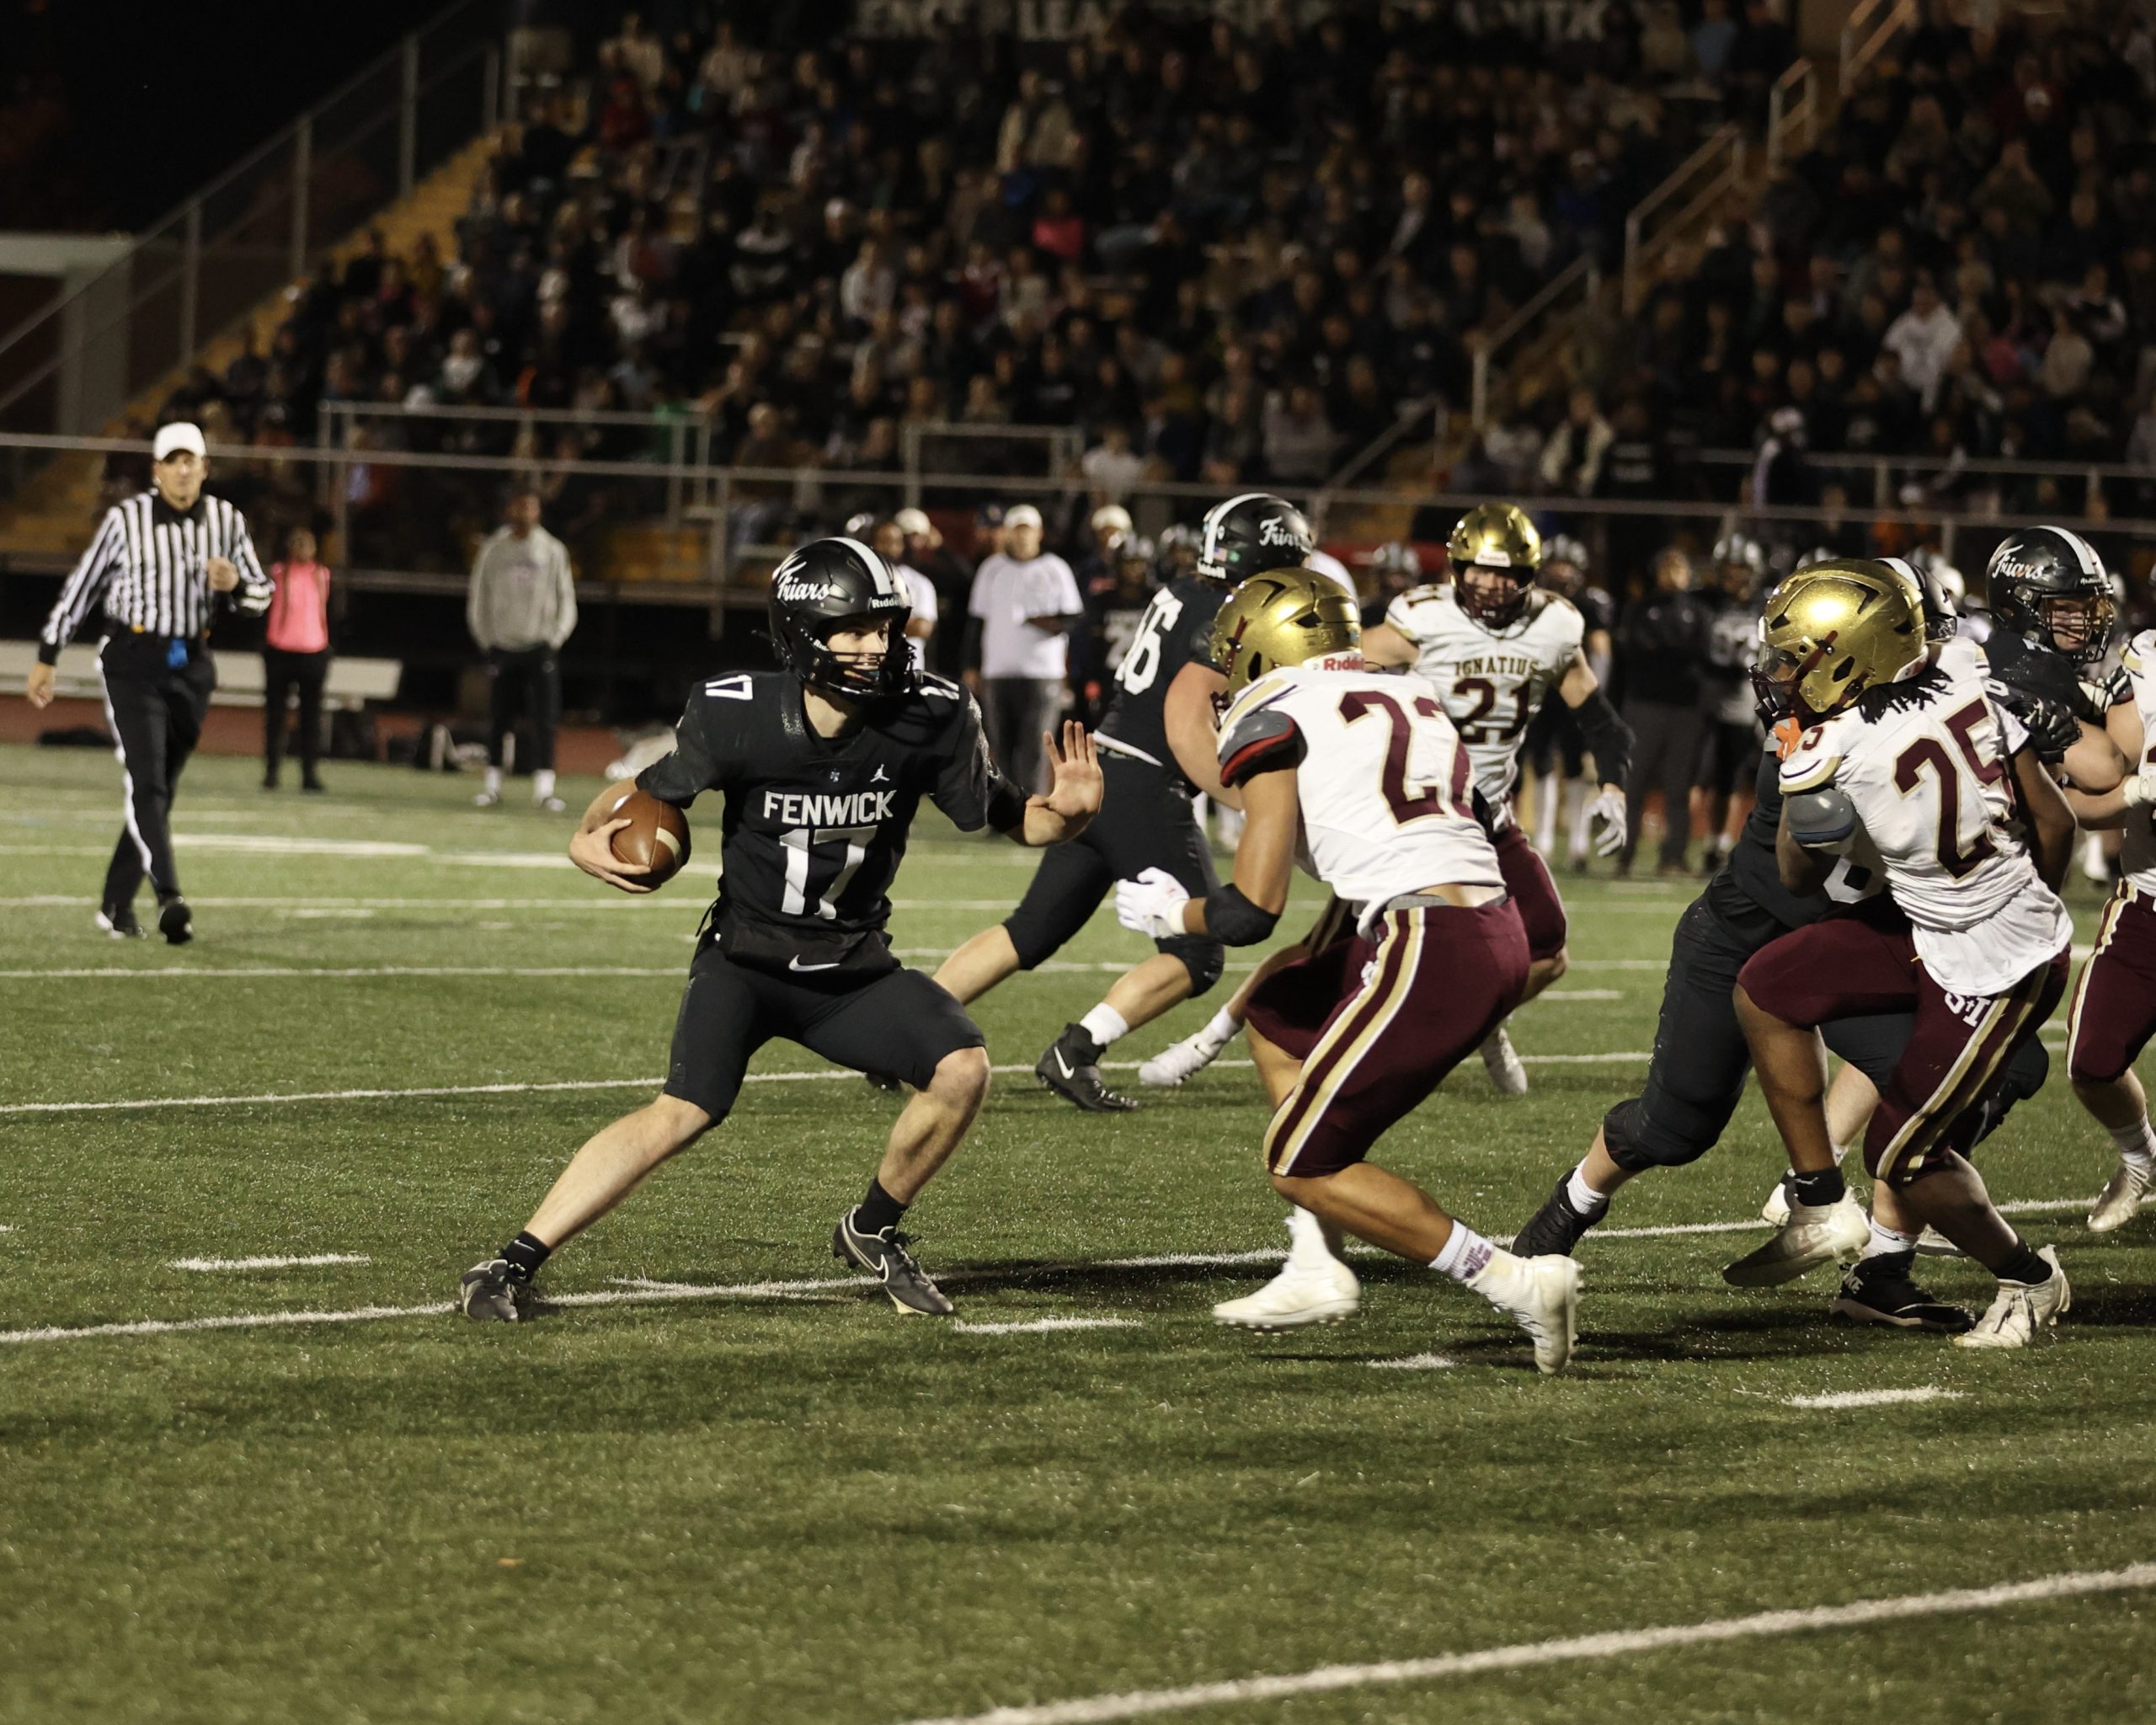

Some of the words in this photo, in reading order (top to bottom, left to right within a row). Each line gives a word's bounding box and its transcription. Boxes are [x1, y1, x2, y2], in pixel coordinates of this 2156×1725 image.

[776, 561, 830, 601] Friars
[1992, 544, 2044, 580] Friars
[1454, 654, 1540, 677] IGNATIUS
[1452, 677, 1530, 745] 21
[763, 790, 898, 826] FENWICK
[1892, 693, 2016, 883] 25
[779, 825, 878, 920] 17
